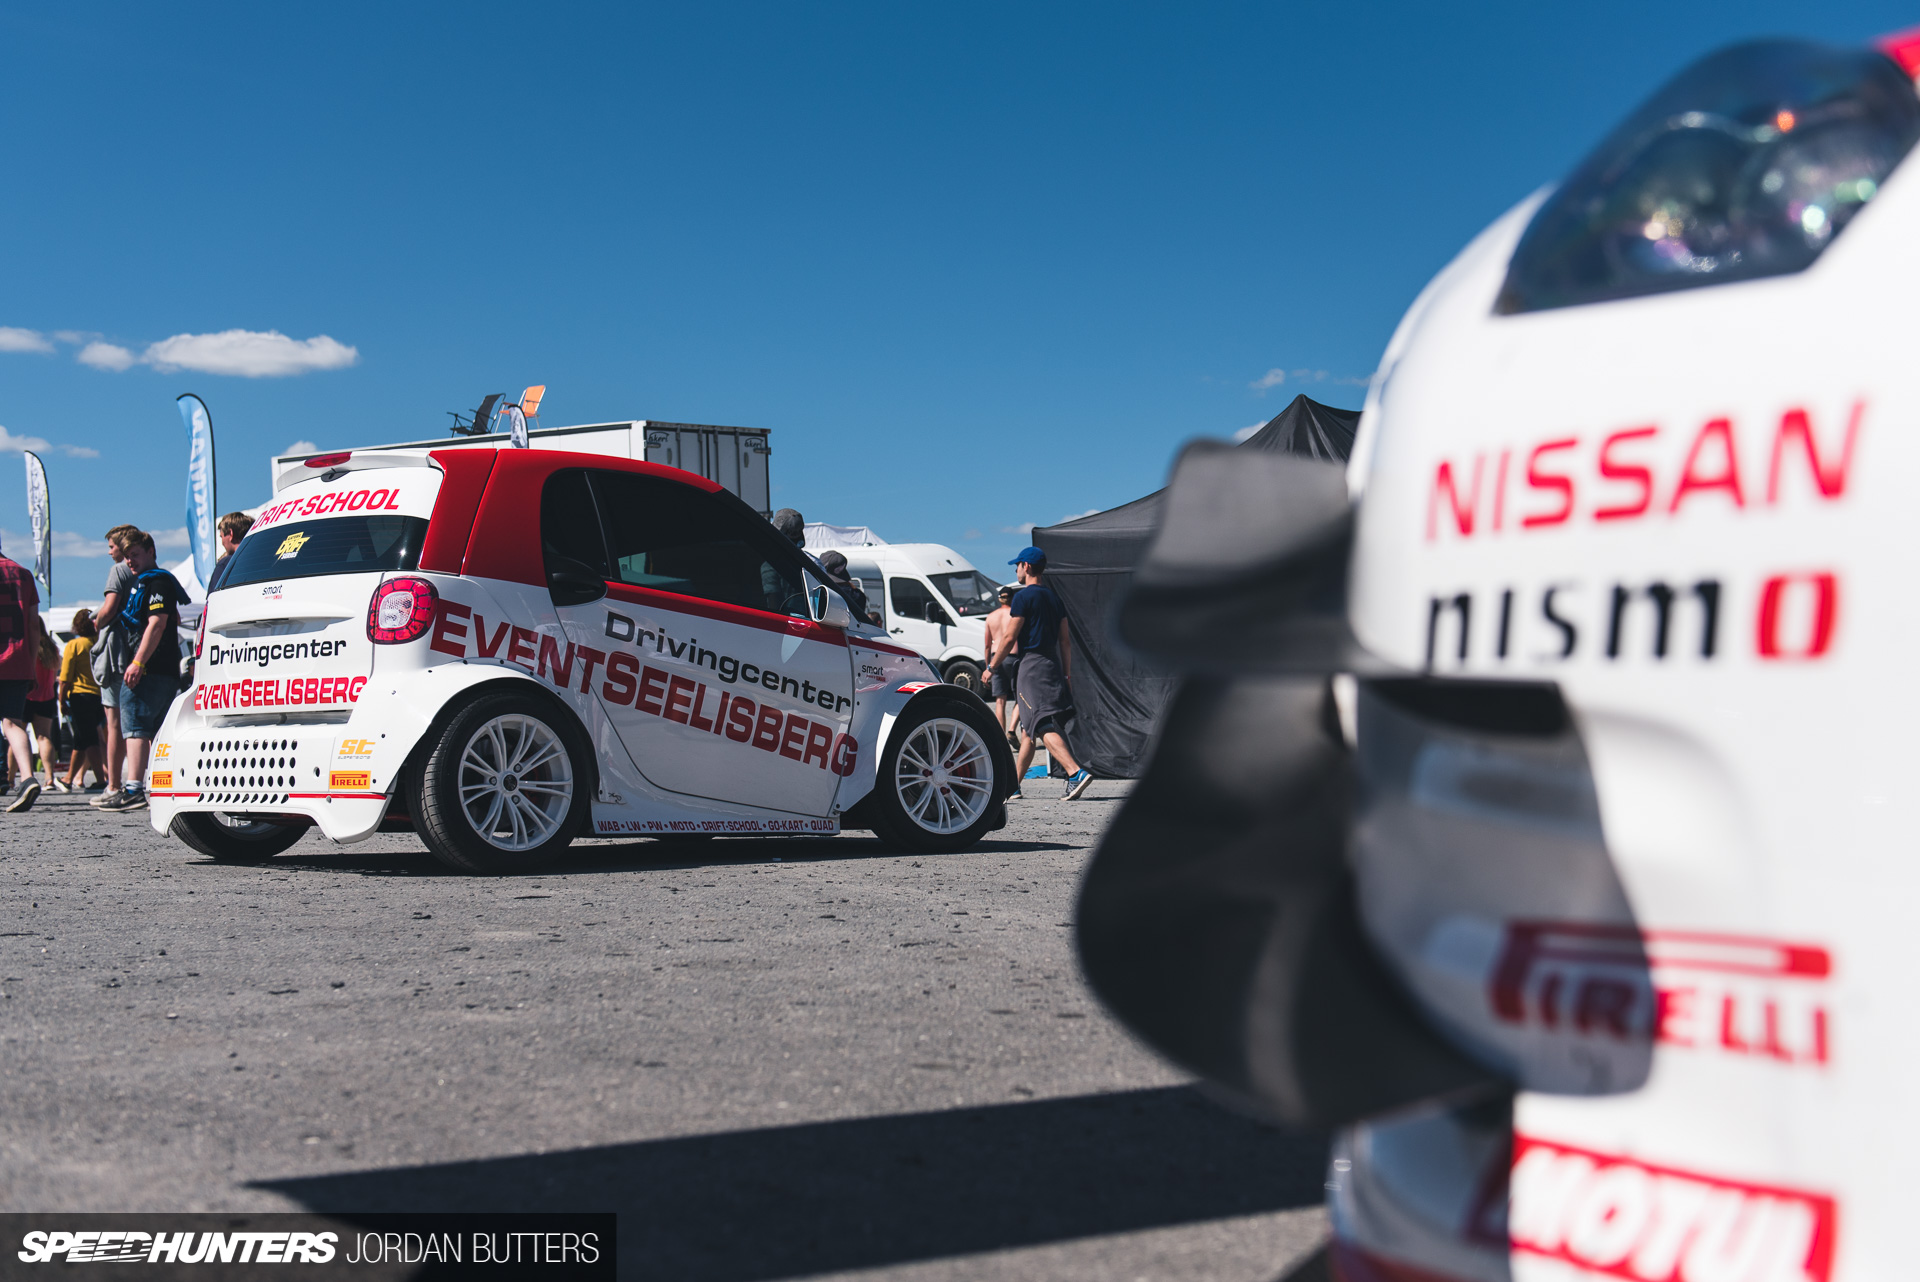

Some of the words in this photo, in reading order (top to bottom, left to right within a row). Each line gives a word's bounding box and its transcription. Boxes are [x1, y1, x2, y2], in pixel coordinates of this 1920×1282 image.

[1425, 397, 1867, 543] NISSAN
[251, 489, 400, 531] DRIFT-SCHOOL
[262, 584, 282, 596] smart
[210, 639, 347, 667] Drivingcenter
[605, 611, 850, 713] Drivingcenter
[861, 665, 884, 676] smart
[194, 676, 367, 710] EVENTSEELISBERG
[430, 600, 859, 777] EVENTSEELISBERG
[152, 774, 171, 786] PIRELLI
[332, 774, 367, 786] PIRELLI
[597, 820, 620, 831] WAB
[627, 821, 641, 831] LW
[648, 821, 663, 831] PW
[670, 821, 697, 831] MOTO
[701, 820, 763, 832] DRIFT-SCHOOL
[768, 820, 805, 831] GO-KART
[810, 820, 834, 831] QUAD
[1486, 920, 1832, 1066] PIRELLI
[1484, 1146, 1822, 1282] MOTUL
